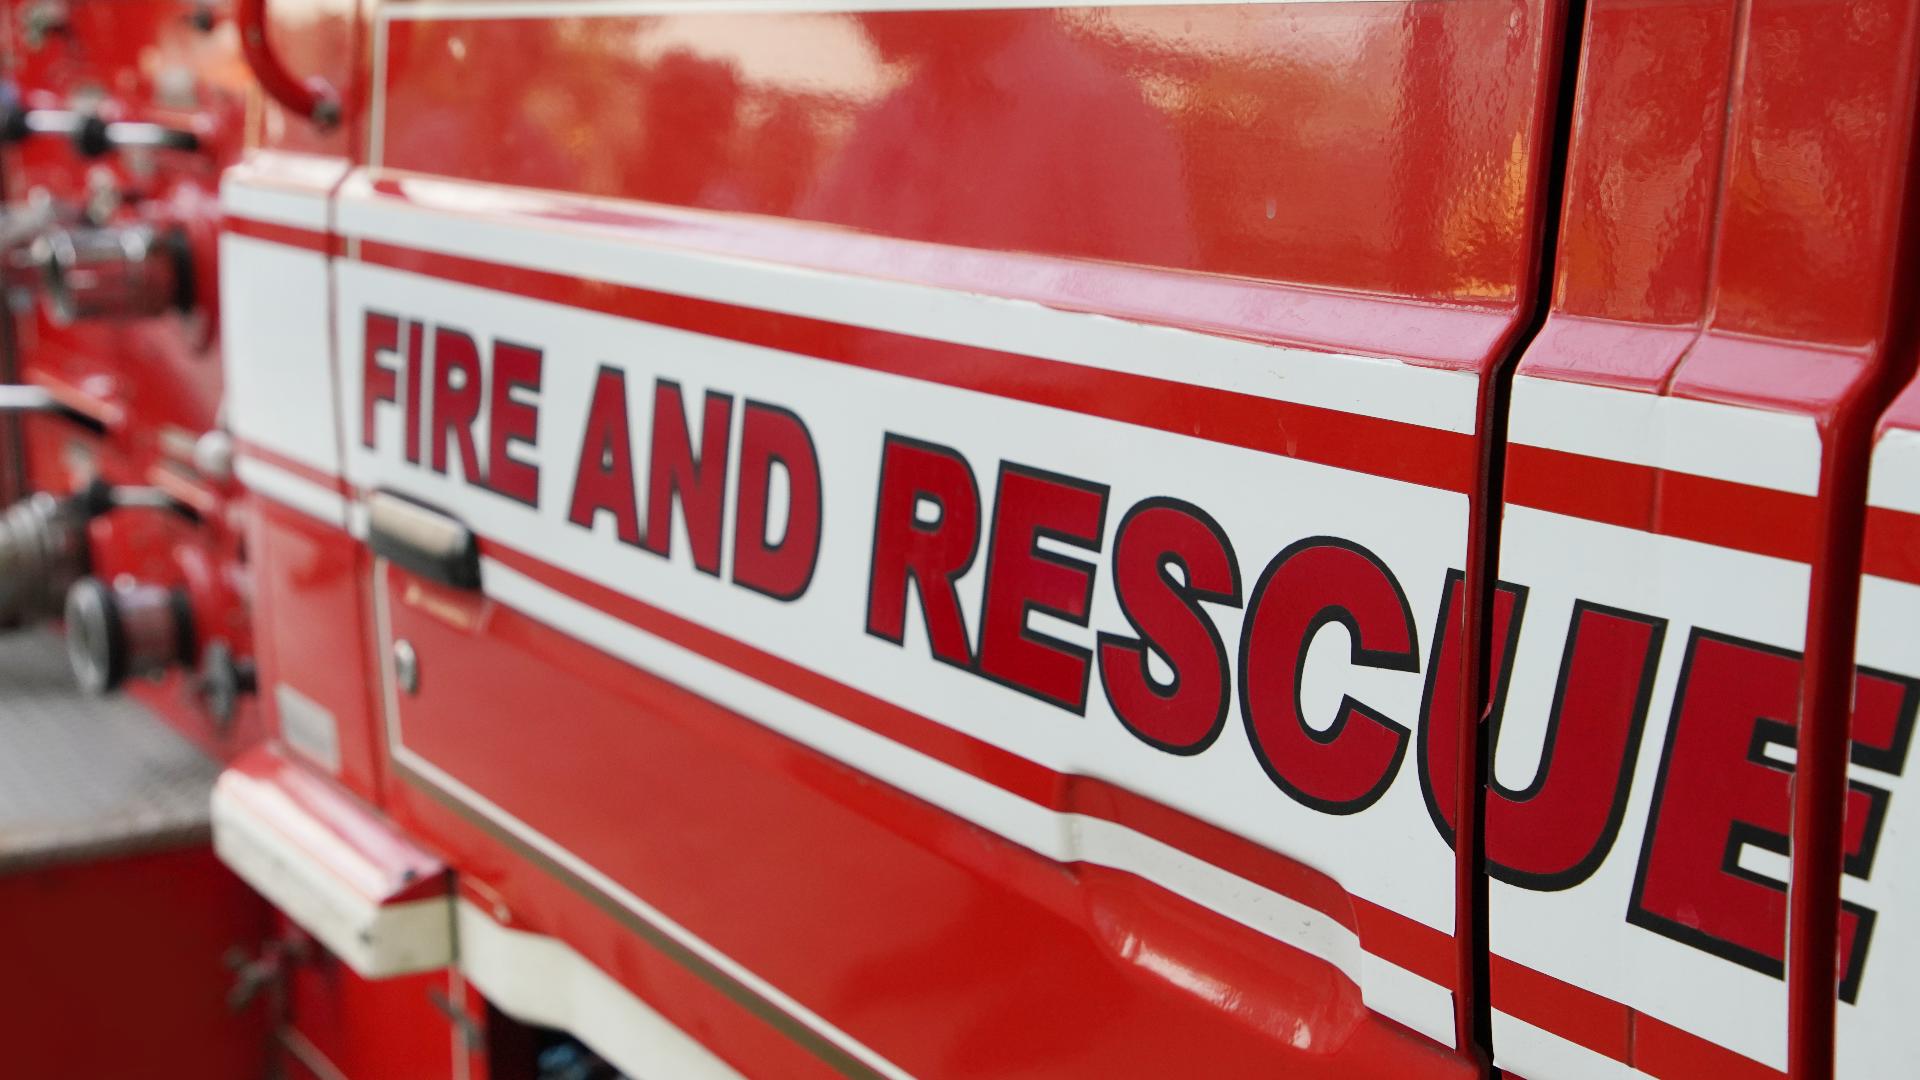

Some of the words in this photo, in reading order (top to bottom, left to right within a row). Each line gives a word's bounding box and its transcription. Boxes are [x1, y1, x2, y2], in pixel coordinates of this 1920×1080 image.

[363, 309, 543, 510] FIRE
[568, 363, 823, 603] AND
[865, 432, 1920, 1006] RESCUE
